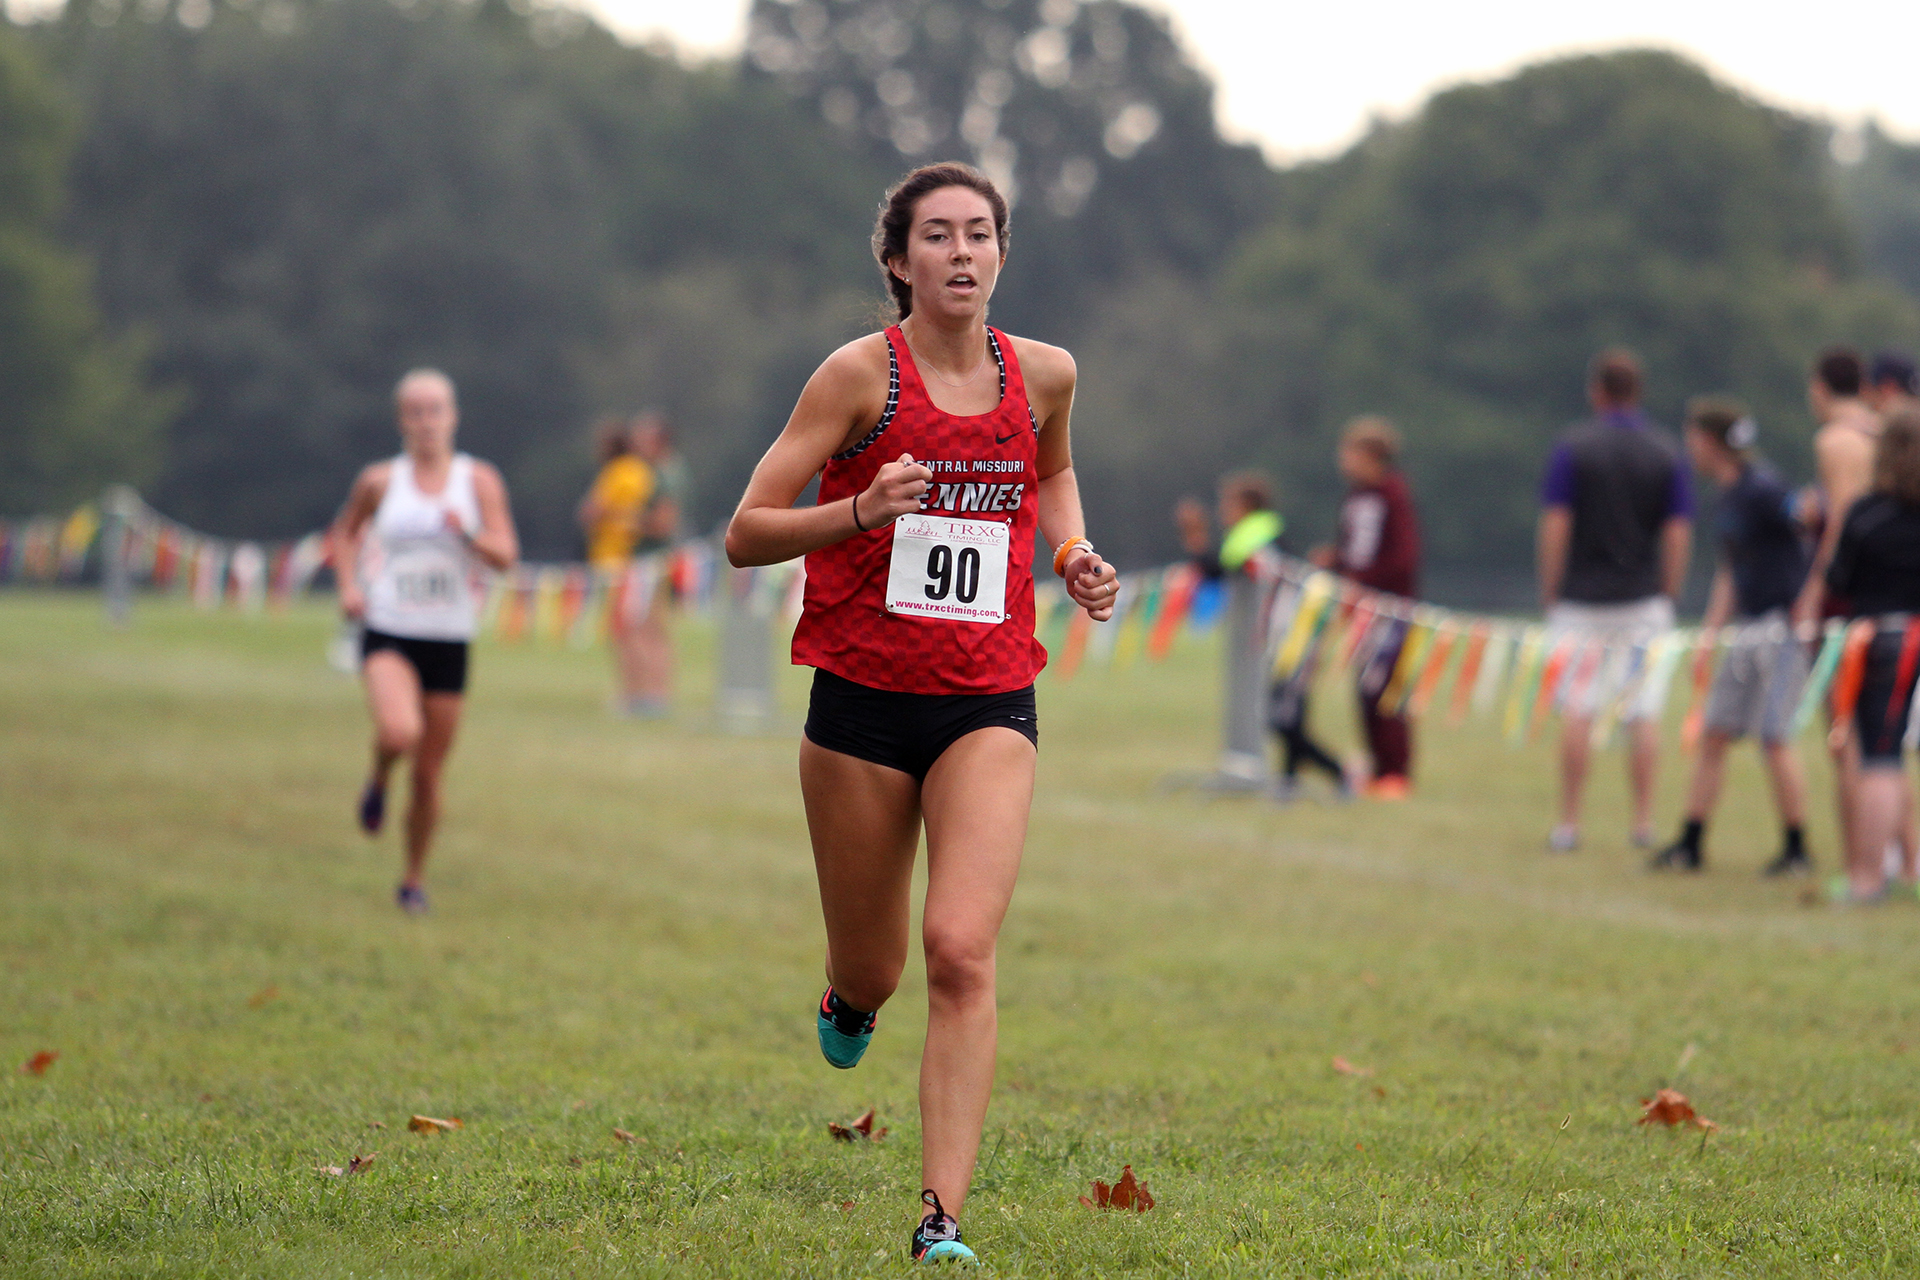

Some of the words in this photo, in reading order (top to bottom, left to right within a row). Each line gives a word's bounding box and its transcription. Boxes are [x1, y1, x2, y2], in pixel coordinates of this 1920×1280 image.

[915, 460, 968, 473] NTRAL
[972, 460, 1024, 473] MISSOURI
[914, 482, 1025, 512] ENNIES
[944, 522, 1004, 539] TRXC
[924, 544, 981, 604] 90
[895, 600, 998, 618] www.trxctiming.com
